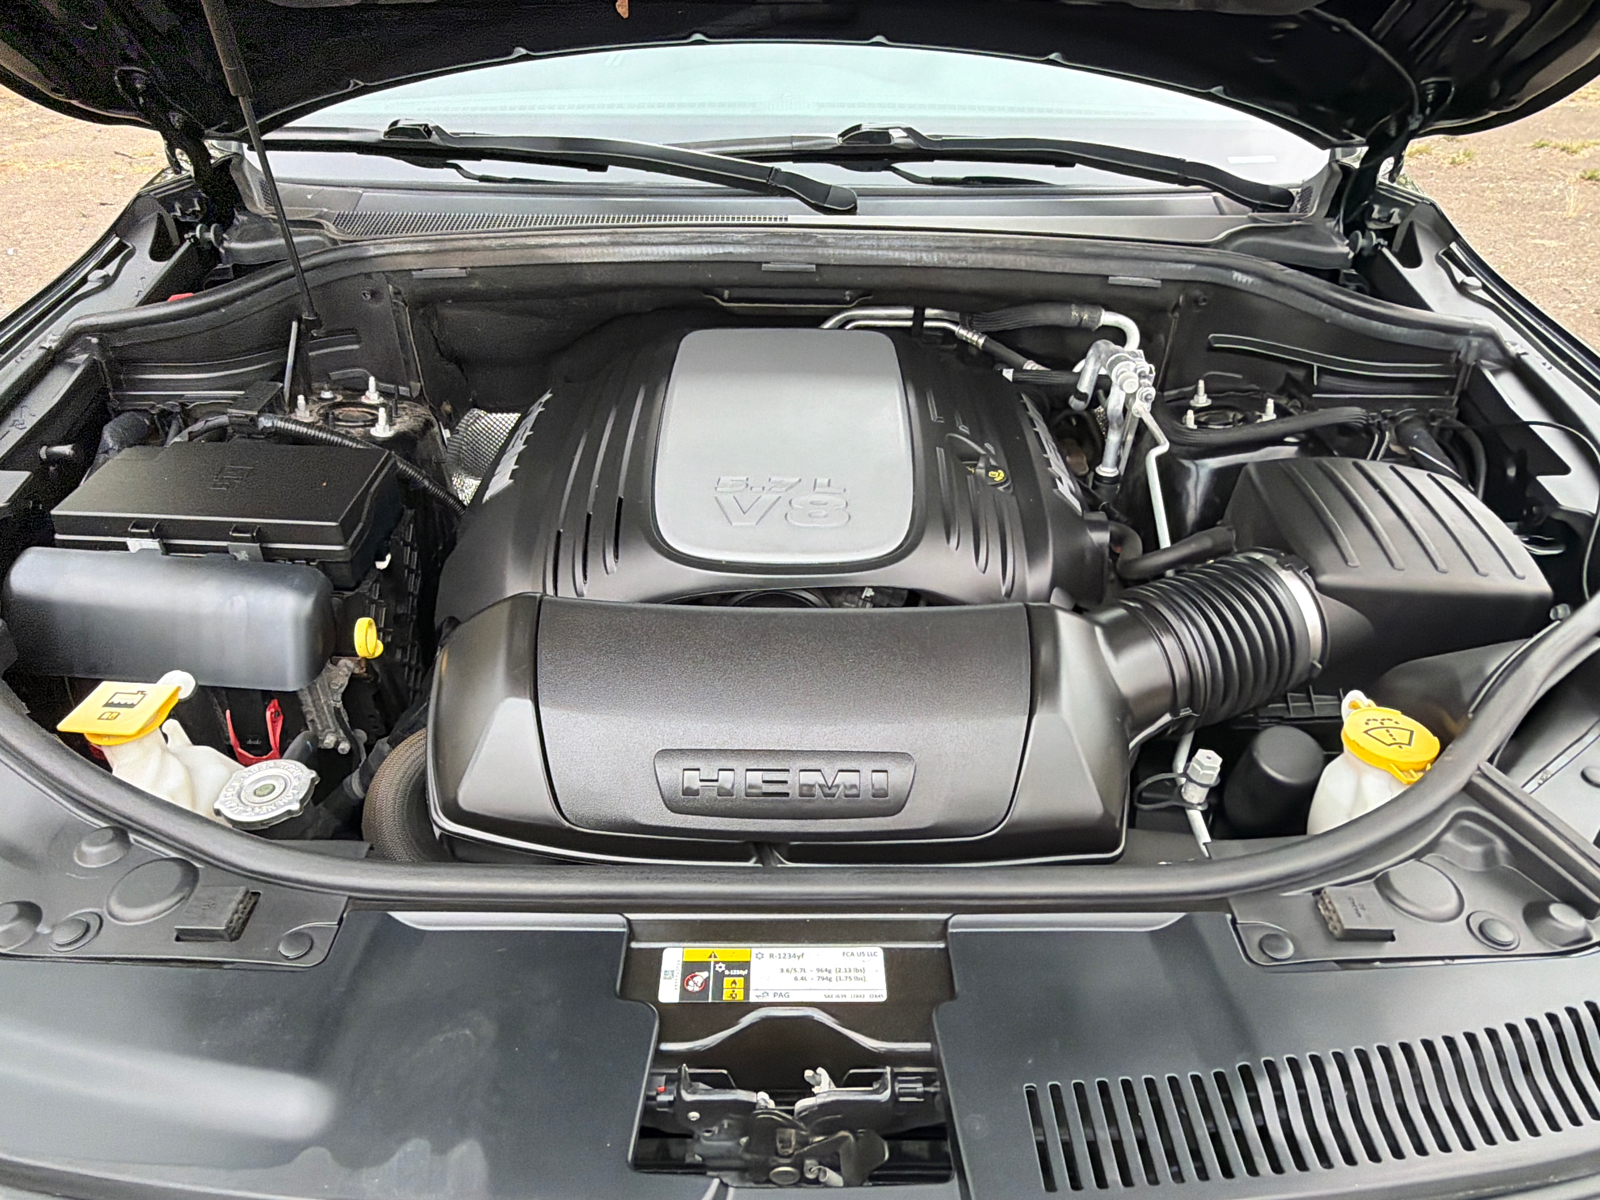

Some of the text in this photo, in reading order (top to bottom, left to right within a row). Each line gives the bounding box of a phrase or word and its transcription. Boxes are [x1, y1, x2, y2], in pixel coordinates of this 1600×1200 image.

[714, 475, 847, 493] 5.7L
[714, 494, 851, 528] V8
[681, 768, 889, 798] HEMI
[768, 952, 805, 960] R-1234yf
[773, 991, 790, 999] PAG
